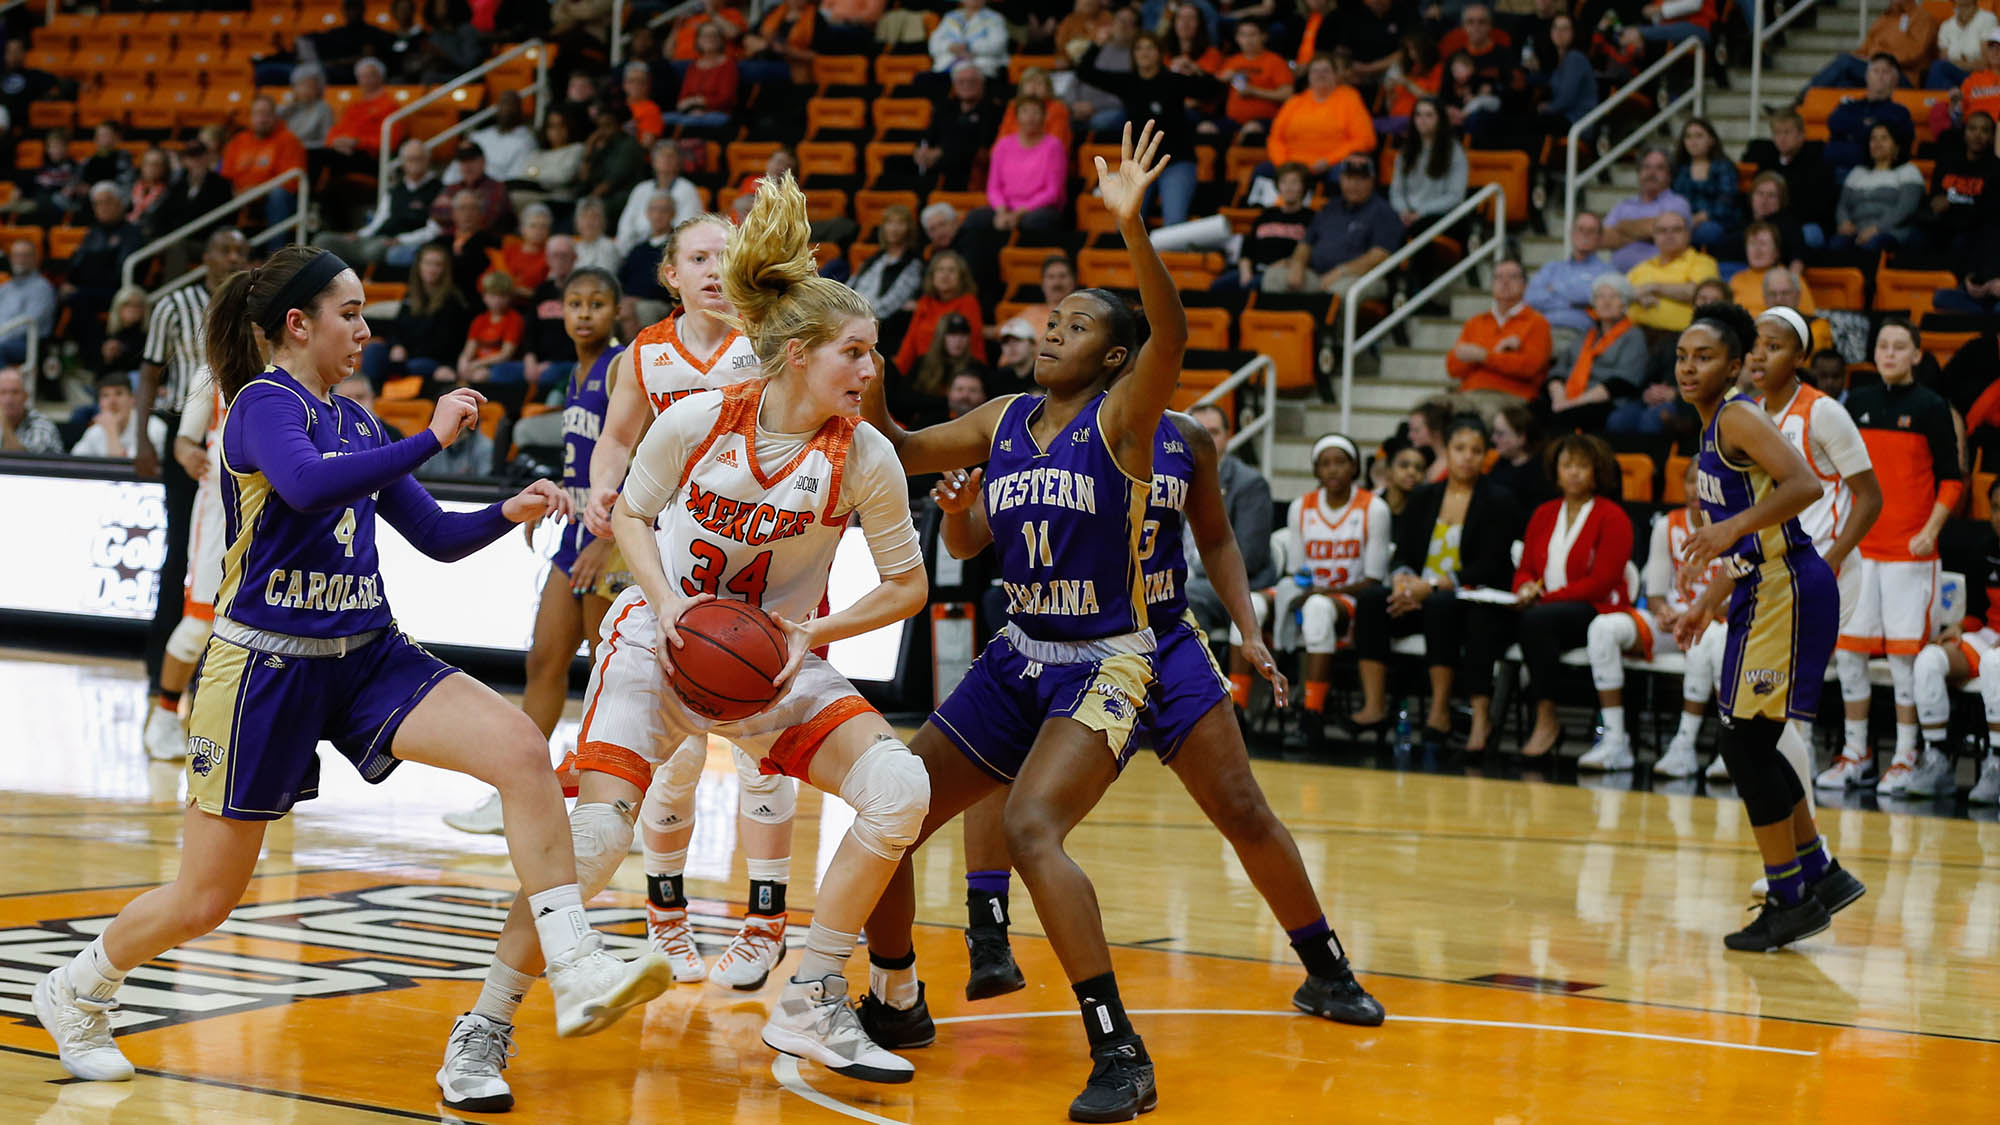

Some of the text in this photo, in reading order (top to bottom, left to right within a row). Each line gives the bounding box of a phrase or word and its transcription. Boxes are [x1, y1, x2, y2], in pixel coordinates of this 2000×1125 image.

[685, 480, 815, 546] MERCER
[988, 467, 1096, 518] WESTERN
[333, 507, 357, 558] 4
[1021, 520, 1054, 569] 11
[680, 538, 773, 610] 34
[188, 735, 225, 765] WCU
